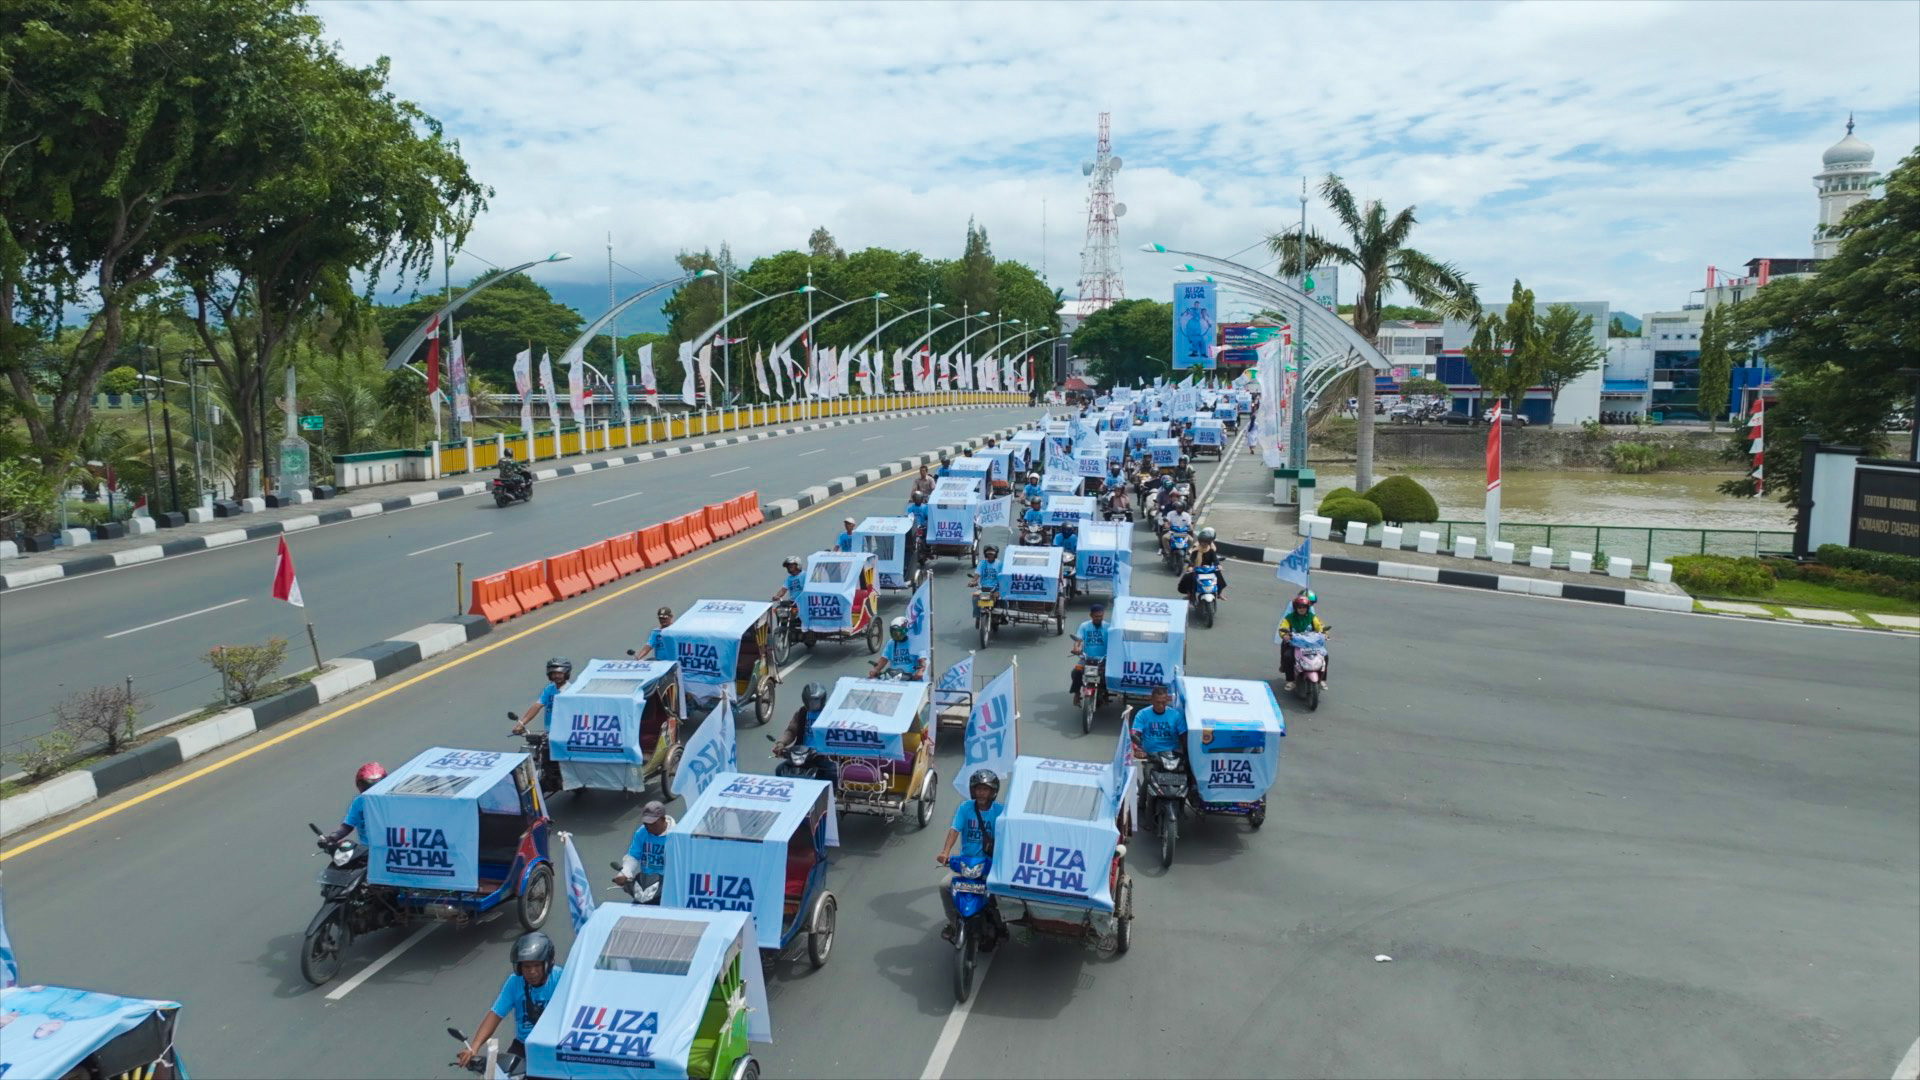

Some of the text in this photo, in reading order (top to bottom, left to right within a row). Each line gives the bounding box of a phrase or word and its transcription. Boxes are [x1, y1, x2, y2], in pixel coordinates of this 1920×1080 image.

[1864, 495, 1917, 511] TENTARA NASIONAL
[1858, 517, 1919, 537] KOMANDO DAERAH
[808, 596, 840, 608] ILLIZA
[808, 606, 843, 617] AFDHAL
[678, 642, 719, 659] ILLIZA
[678, 656, 721, 672] AFDHAL
[1123, 661, 1164, 676] ILLIZA
[1120, 675, 1165, 687] AFDHAL
[572, 714, 622, 732] ILLIZA
[567, 731, 624, 748] AFDHAL
[826, 728, 884, 744] AFDHAL
[1211, 760, 1253, 773] ILLIZA
[1208, 772, 1255, 784] AFDHAL
[721, 783, 792, 798] AFDHAL
[386, 827, 449, 850] ILLIZA
[385, 848, 454, 868] AFDHAL
[1018, 842, 1086, 872] ILLIZA
[1011, 864, 1089, 892] AFDHAL
[689, 873, 755, 901] ILLIZA
[572, 1005, 658, 1035] ILLIZA
[556, 1030, 655, 1057] AFDHAL
